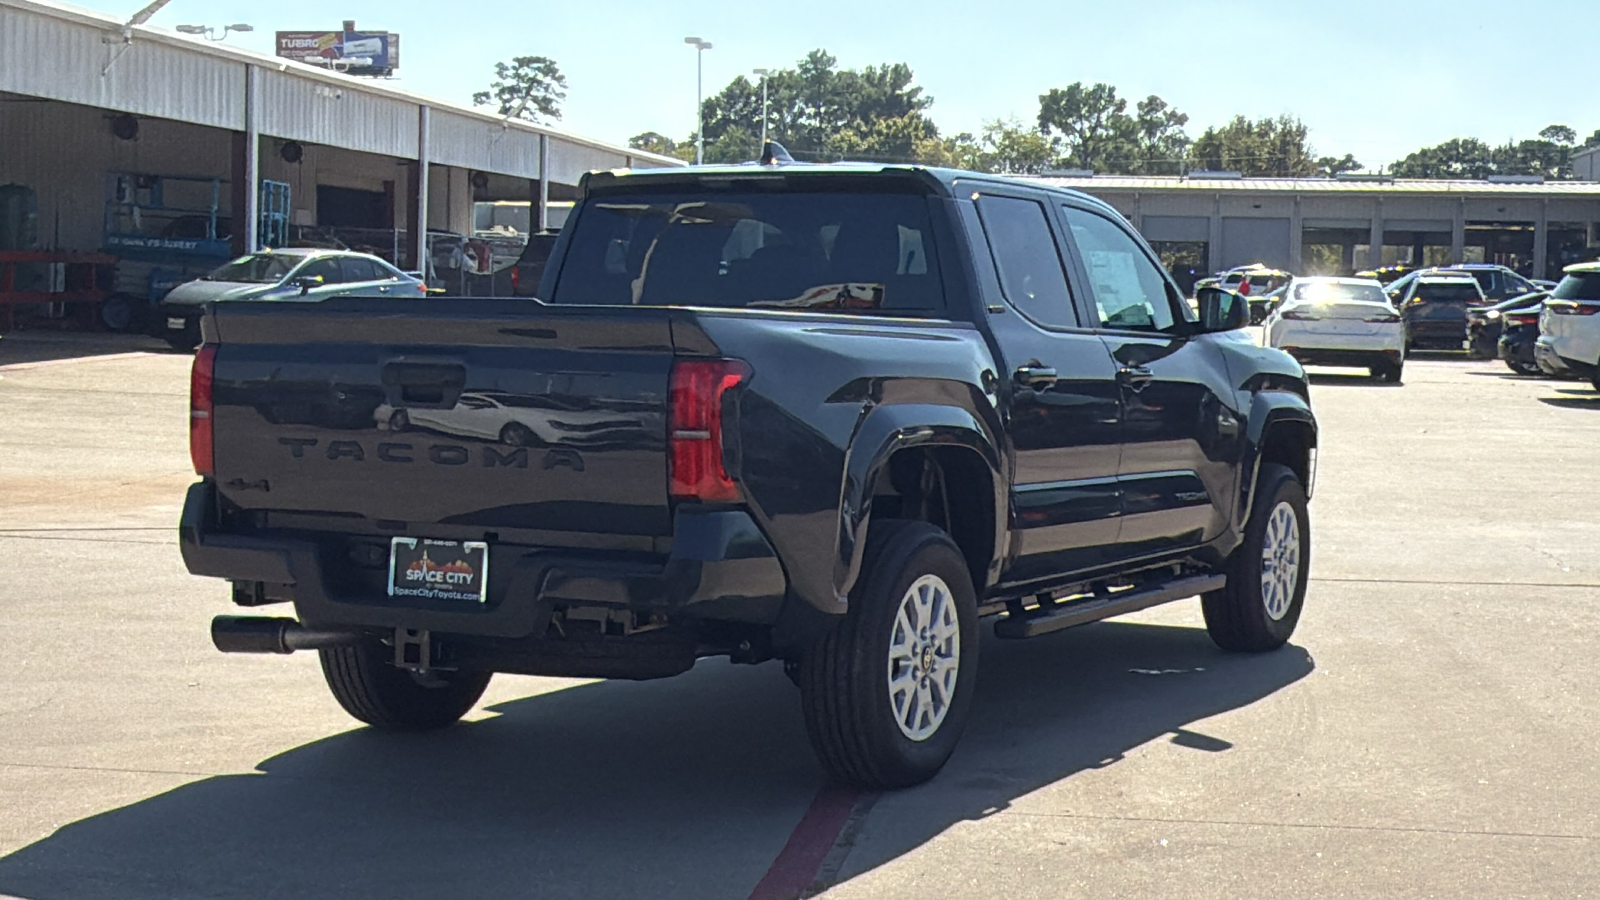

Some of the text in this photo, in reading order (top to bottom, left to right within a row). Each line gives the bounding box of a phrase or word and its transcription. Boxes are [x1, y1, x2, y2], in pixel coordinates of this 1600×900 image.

[278, 437, 585, 472] TACOMA
[406, 569, 474, 584] SPACE CITY
[394, 587, 482, 601] SpaceCityToyota.com
